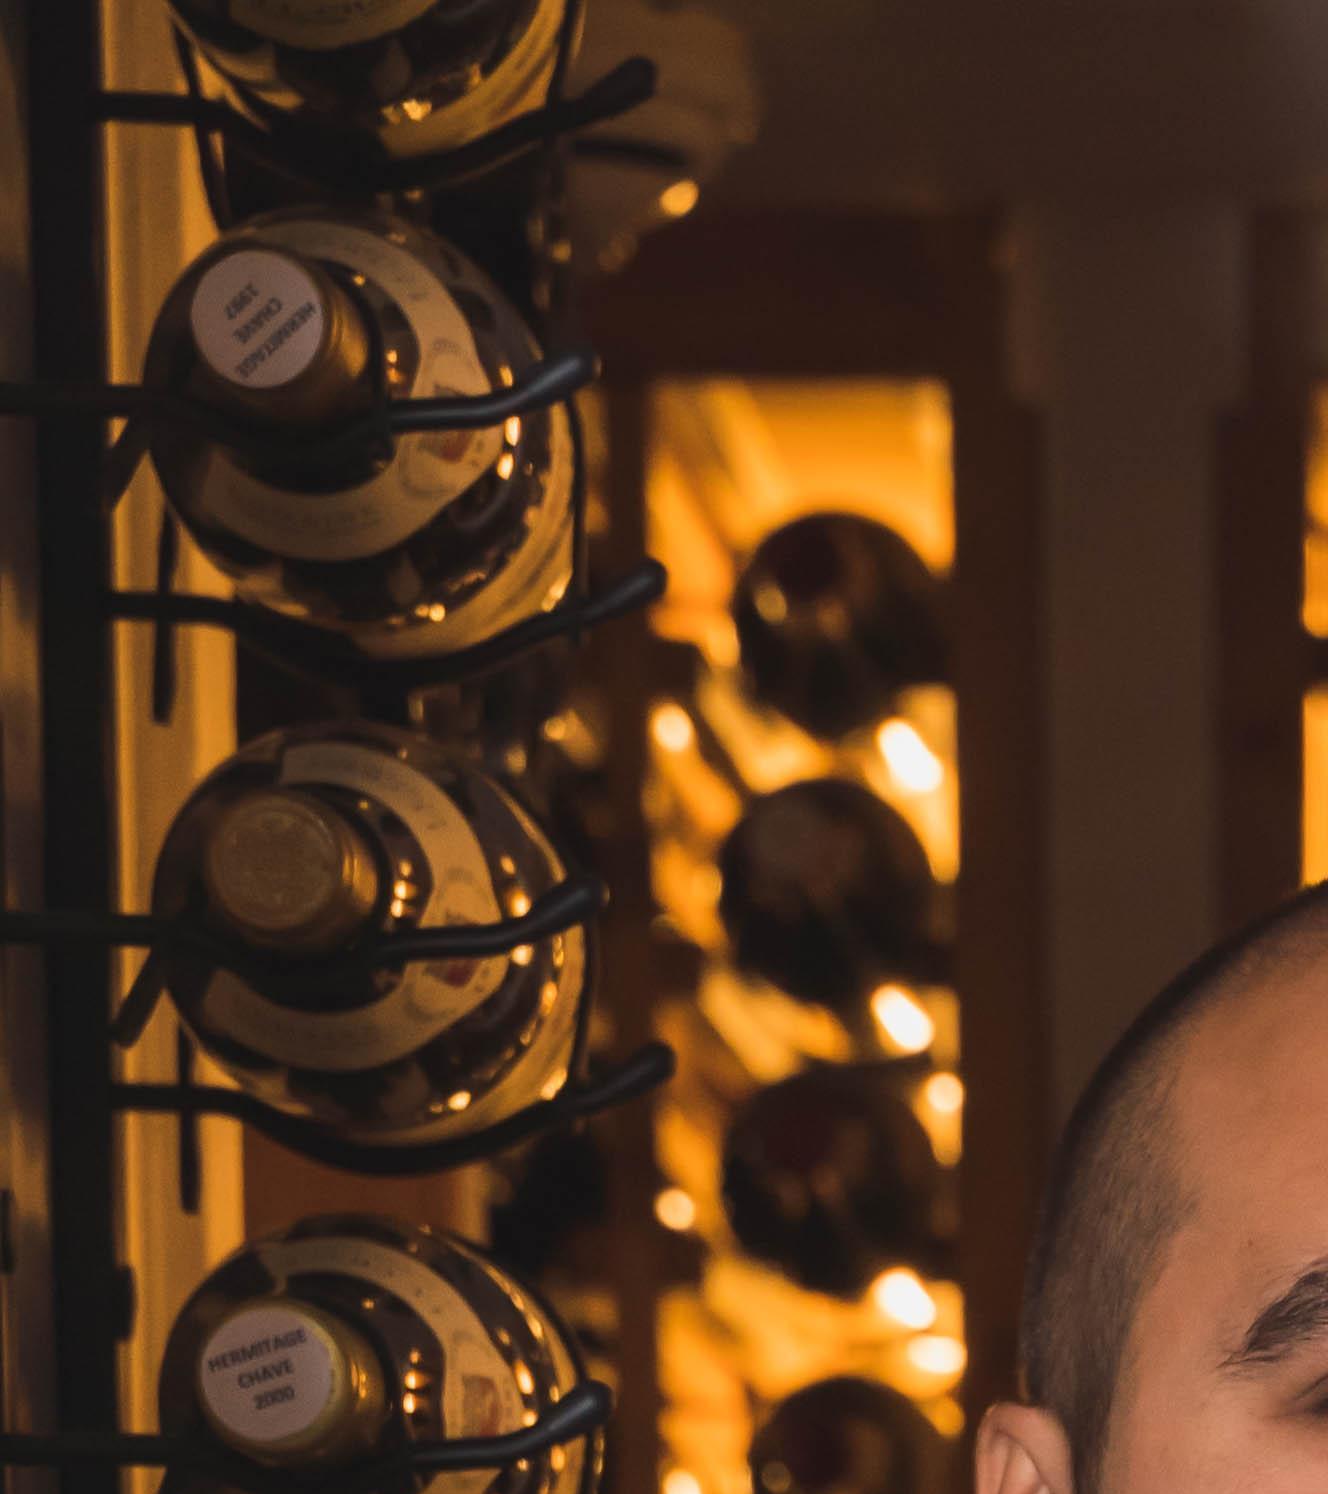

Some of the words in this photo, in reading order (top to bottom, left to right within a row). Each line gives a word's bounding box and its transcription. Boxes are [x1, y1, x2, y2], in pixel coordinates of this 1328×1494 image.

[232, 297, 283, 344] CHAVE
[208, 1325, 307, 1373] HERMITAGE
[237, 1359, 295, 1389] CHAVE
